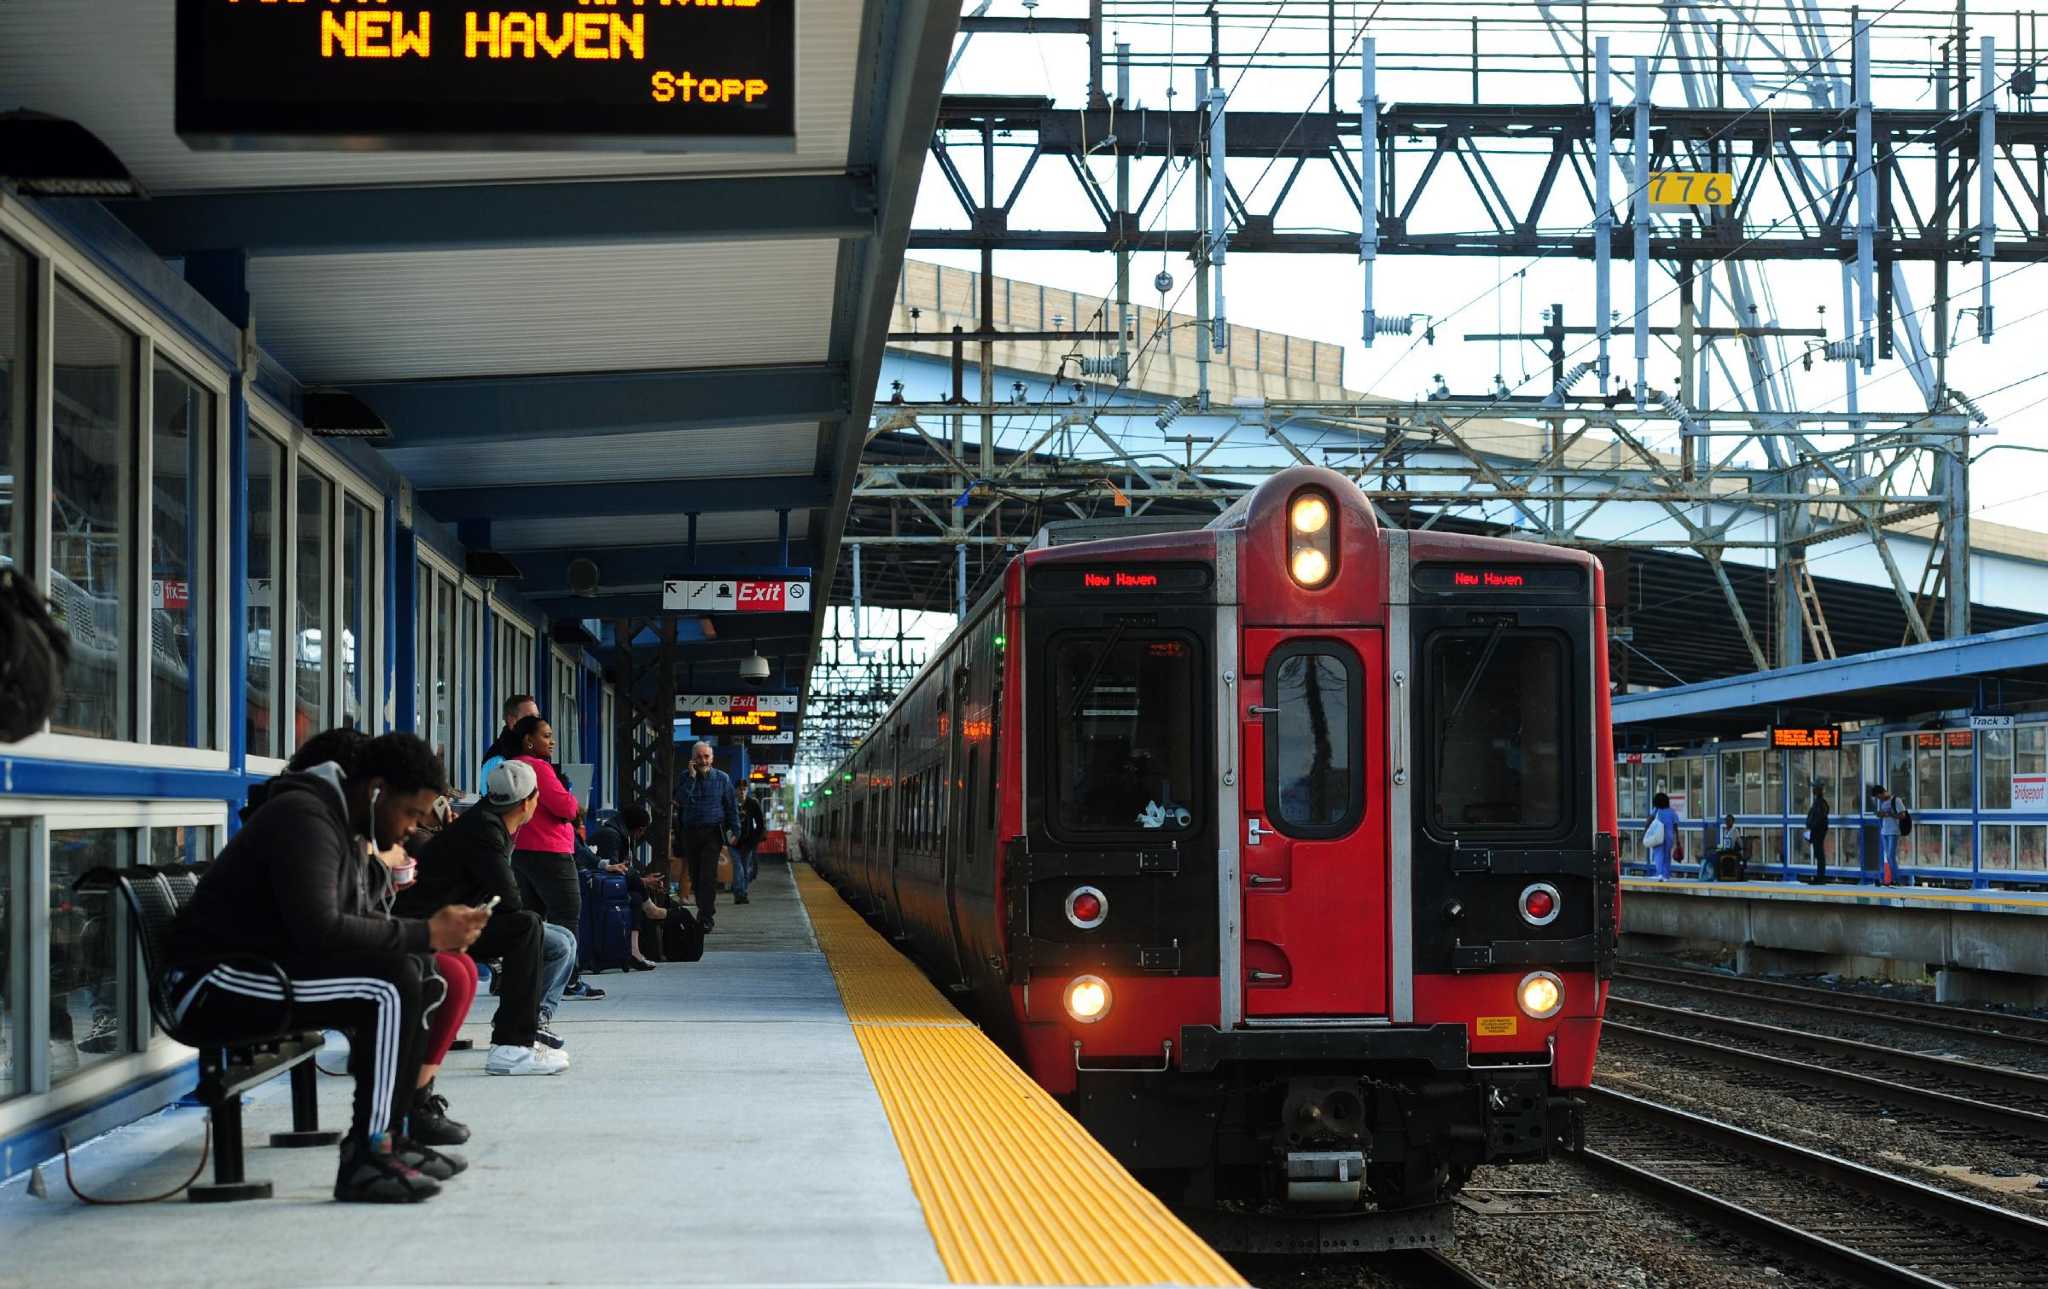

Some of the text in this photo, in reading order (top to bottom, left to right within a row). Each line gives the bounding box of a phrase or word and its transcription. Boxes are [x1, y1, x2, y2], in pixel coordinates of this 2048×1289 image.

[321, 10, 645, 59] NEW HAVEN
[651, 71, 768, 102] Stopp
[1649, 174, 1722, 203] 776
[1084, 572, 1157, 587] New Haven
[1455, 572, 1523, 586] New Haven
[738, 583, 782, 601] Exit
[731, 696, 755, 707] Exit
[711, 716, 760, 725] NEW HAVEN
[1973, 716, 2010, 726] Track 3
[782, 732, 789, 740] 4
[2015, 784, 2045, 803] Bridgeport
